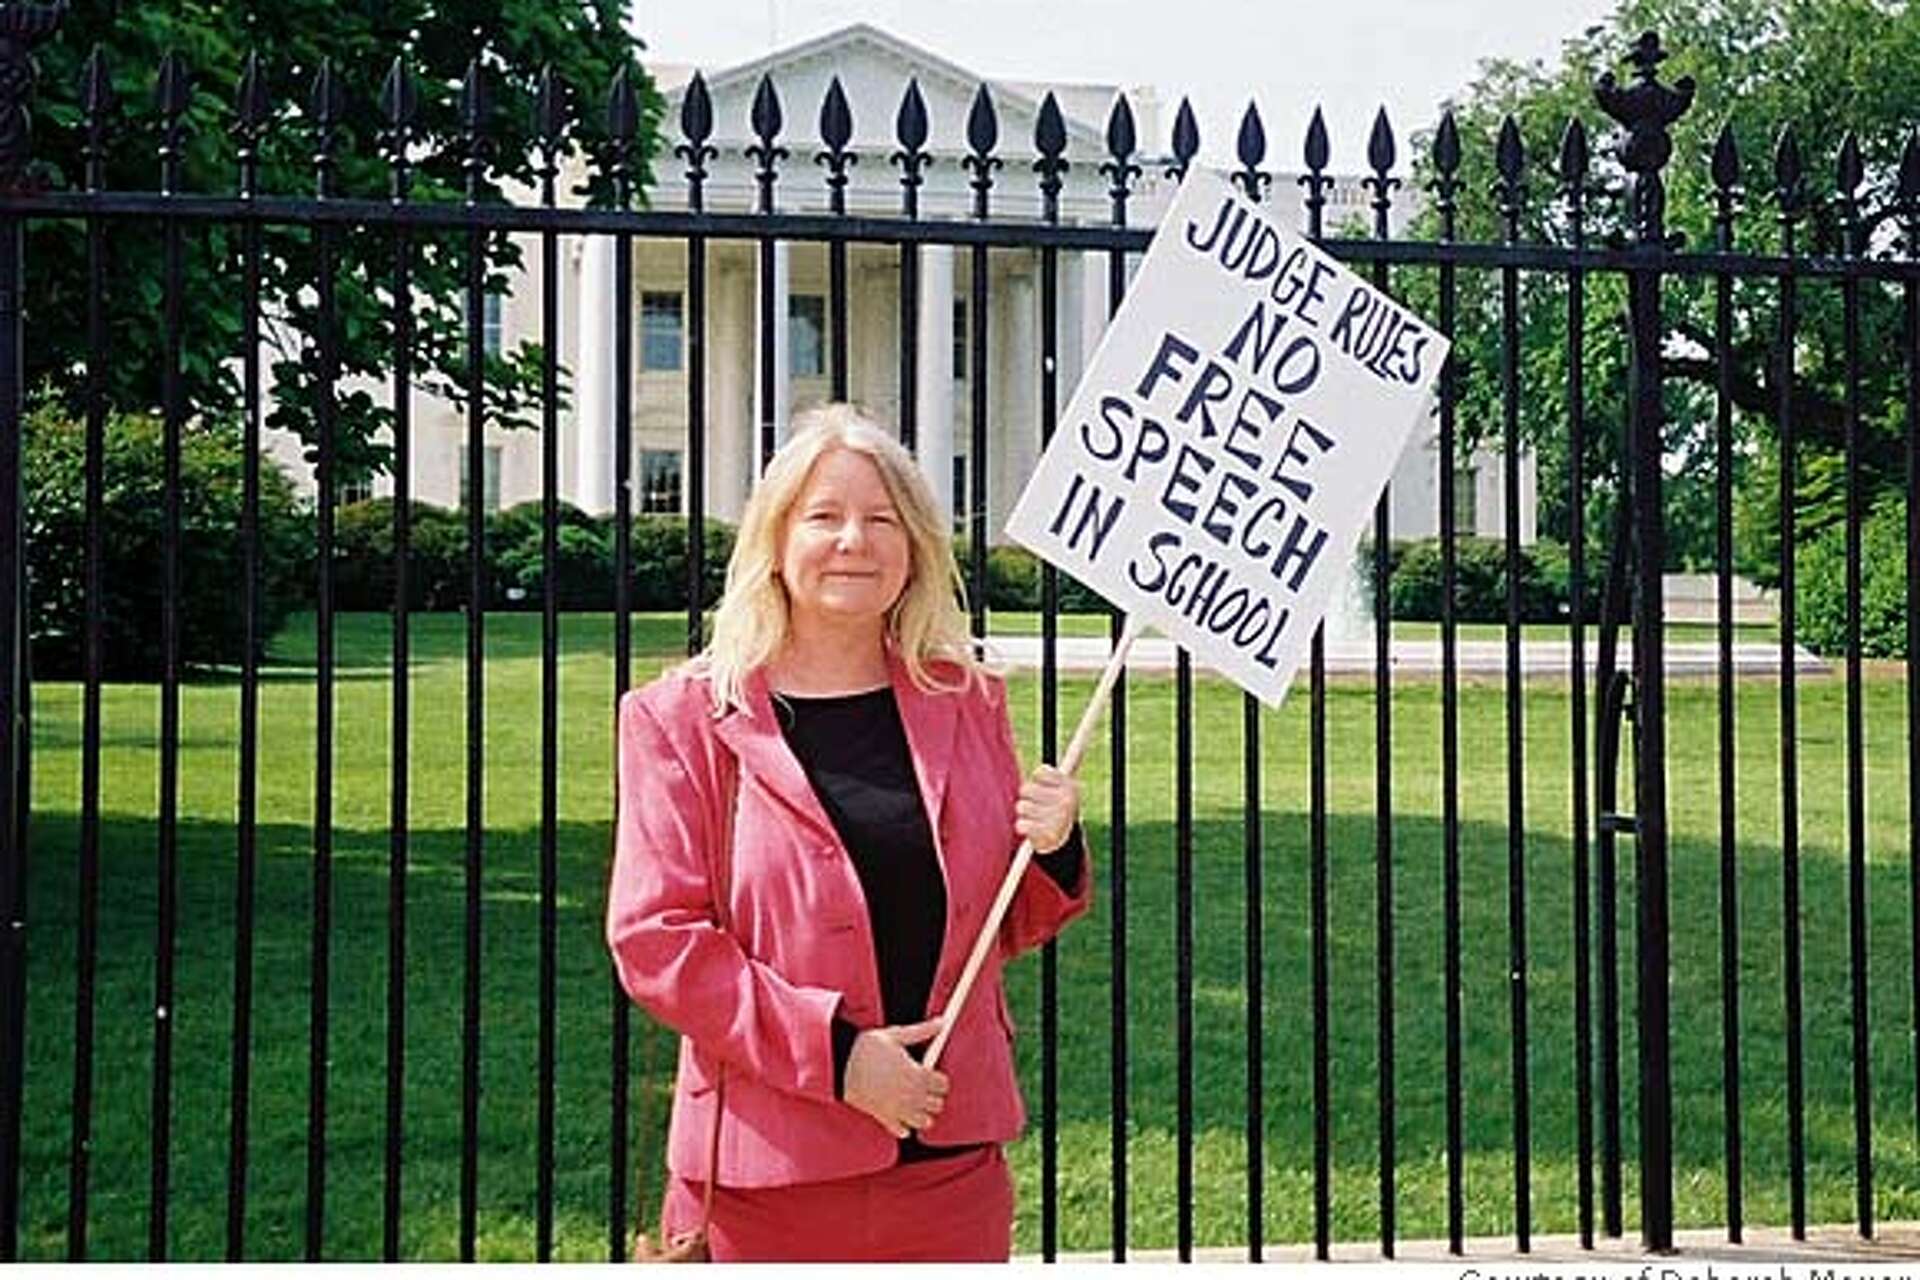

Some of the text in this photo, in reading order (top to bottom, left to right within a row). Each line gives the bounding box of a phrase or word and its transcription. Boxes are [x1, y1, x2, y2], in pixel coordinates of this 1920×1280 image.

[1186, 198, 1429, 385] JUDGE RULES
[1223, 300, 1321, 395] NO
[1080, 396, 1329, 592] SPEECH
[1137, 333, 1336, 502] FREE
[1049, 474, 1290, 670] IN SCHOOL
